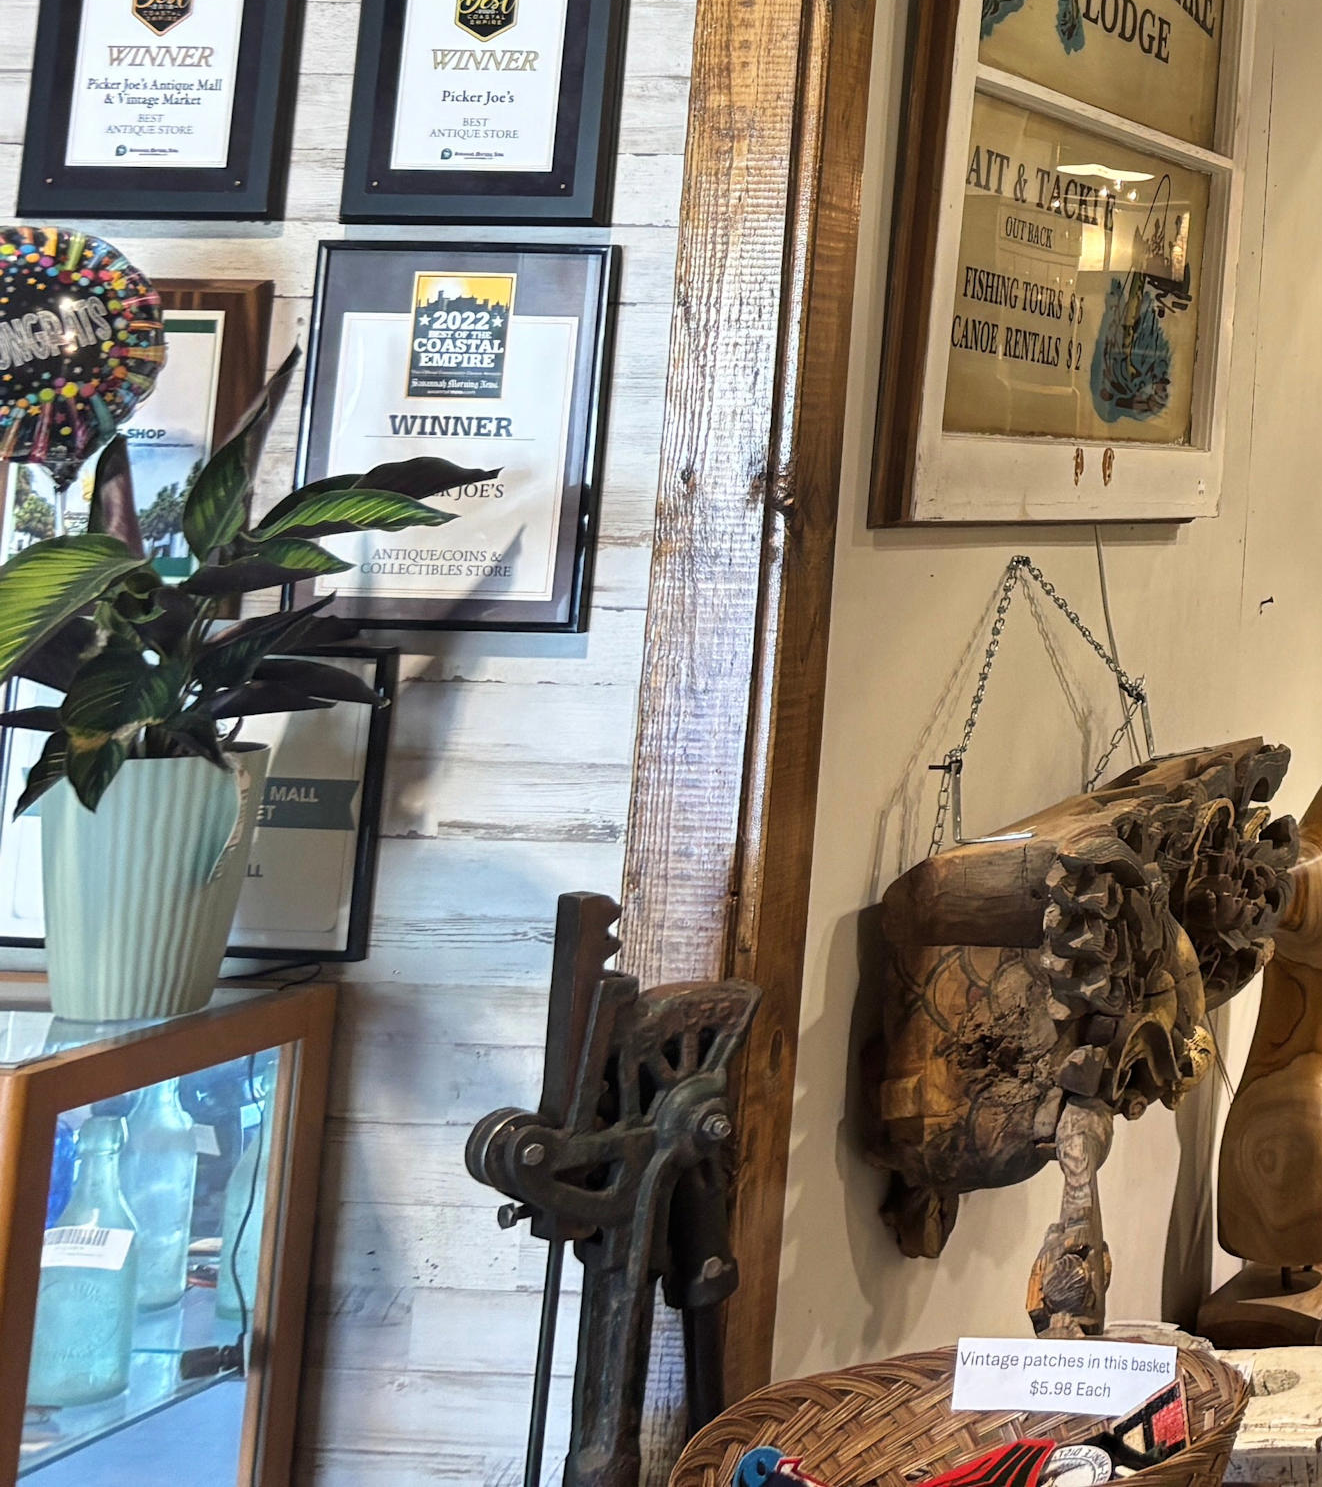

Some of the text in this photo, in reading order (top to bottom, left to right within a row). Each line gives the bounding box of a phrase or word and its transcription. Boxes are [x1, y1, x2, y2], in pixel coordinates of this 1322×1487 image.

[108, 45, 214, 67] WINNER
[431, 49, 539, 71] WINNER
[87, 78, 222, 94] Picker Joe's Antique Mall
[104, 93, 201, 108] & Vintage Market
[441, 90, 514, 105] Picker Joe's
[137, 114, 164, 123] BEST
[462, 117, 488, 127] BEST
[106, 125, 193, 136] ANTIQUE STORE
[429, 128, 519, 140] ANTIQUE STORE
[965, 145, 1010, 196] AIT
[1013, 163, 1028, 203] &
[1005, 216, 1054, 249] OUT BACK
[963, 266, 1020, 310] FISHING
[1022, 280, 1064, 321] TOURS
[432, 311, 491, 330] 2022
[428, 330, 492, 339] BEST OF THE
[951, 315, 999, 355] CANOE
[1003, 327, 1062, 367] RENTALS
[413, 338, 505, 354] COASTAL
[419, 352, 495, 369] EMPIRE
[389, 414, 513, 437] WINNER
[126, 428, 167, 440] SHOP
[452, 483, 505, 501] JOE'S
[371, 548, 503, 563] ANTIQUE/COINS &
[360, 563, 513, 578] COLLECTIBLES STORE
[270, 786, 319, 802] MALL
[960, 1351, 1171, 1374] Vintage patches in this basket
[1029, 1380, 1111, 1398] $5.98 Each
